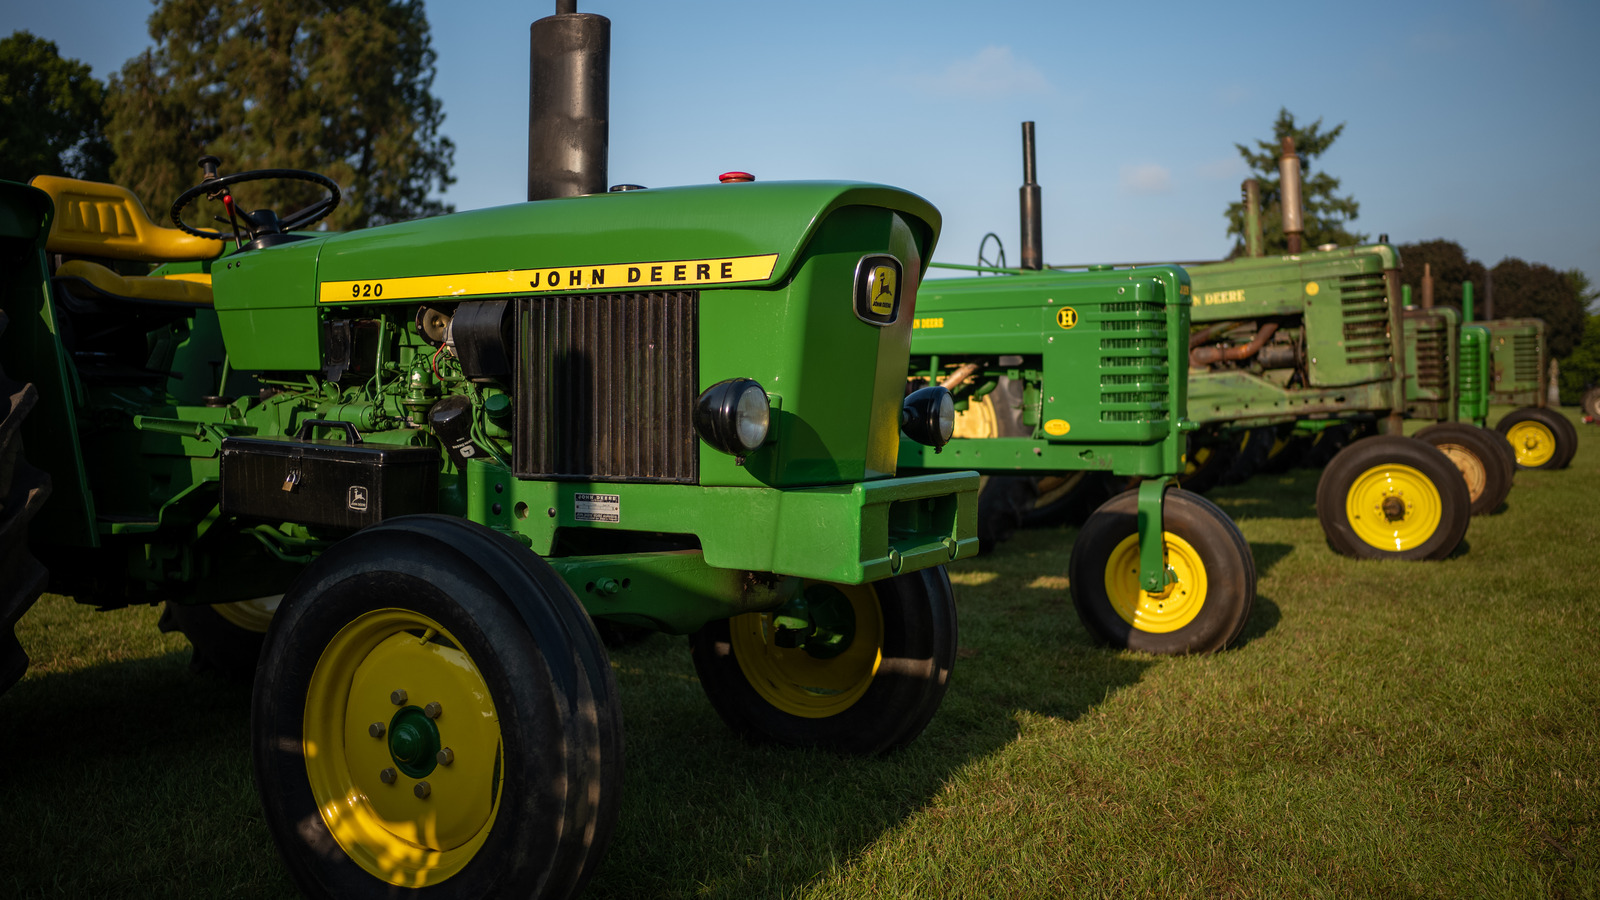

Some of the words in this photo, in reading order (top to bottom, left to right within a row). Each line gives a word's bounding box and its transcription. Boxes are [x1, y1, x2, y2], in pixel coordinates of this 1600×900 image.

[530, 269, 605, 288] JOHN
[627, 262, 733, 283] DEERE
[352, 283, 383, 298] 920
[1204, 289, 1245, 305] DEERE
[1060, 310, 1074, 326] H
